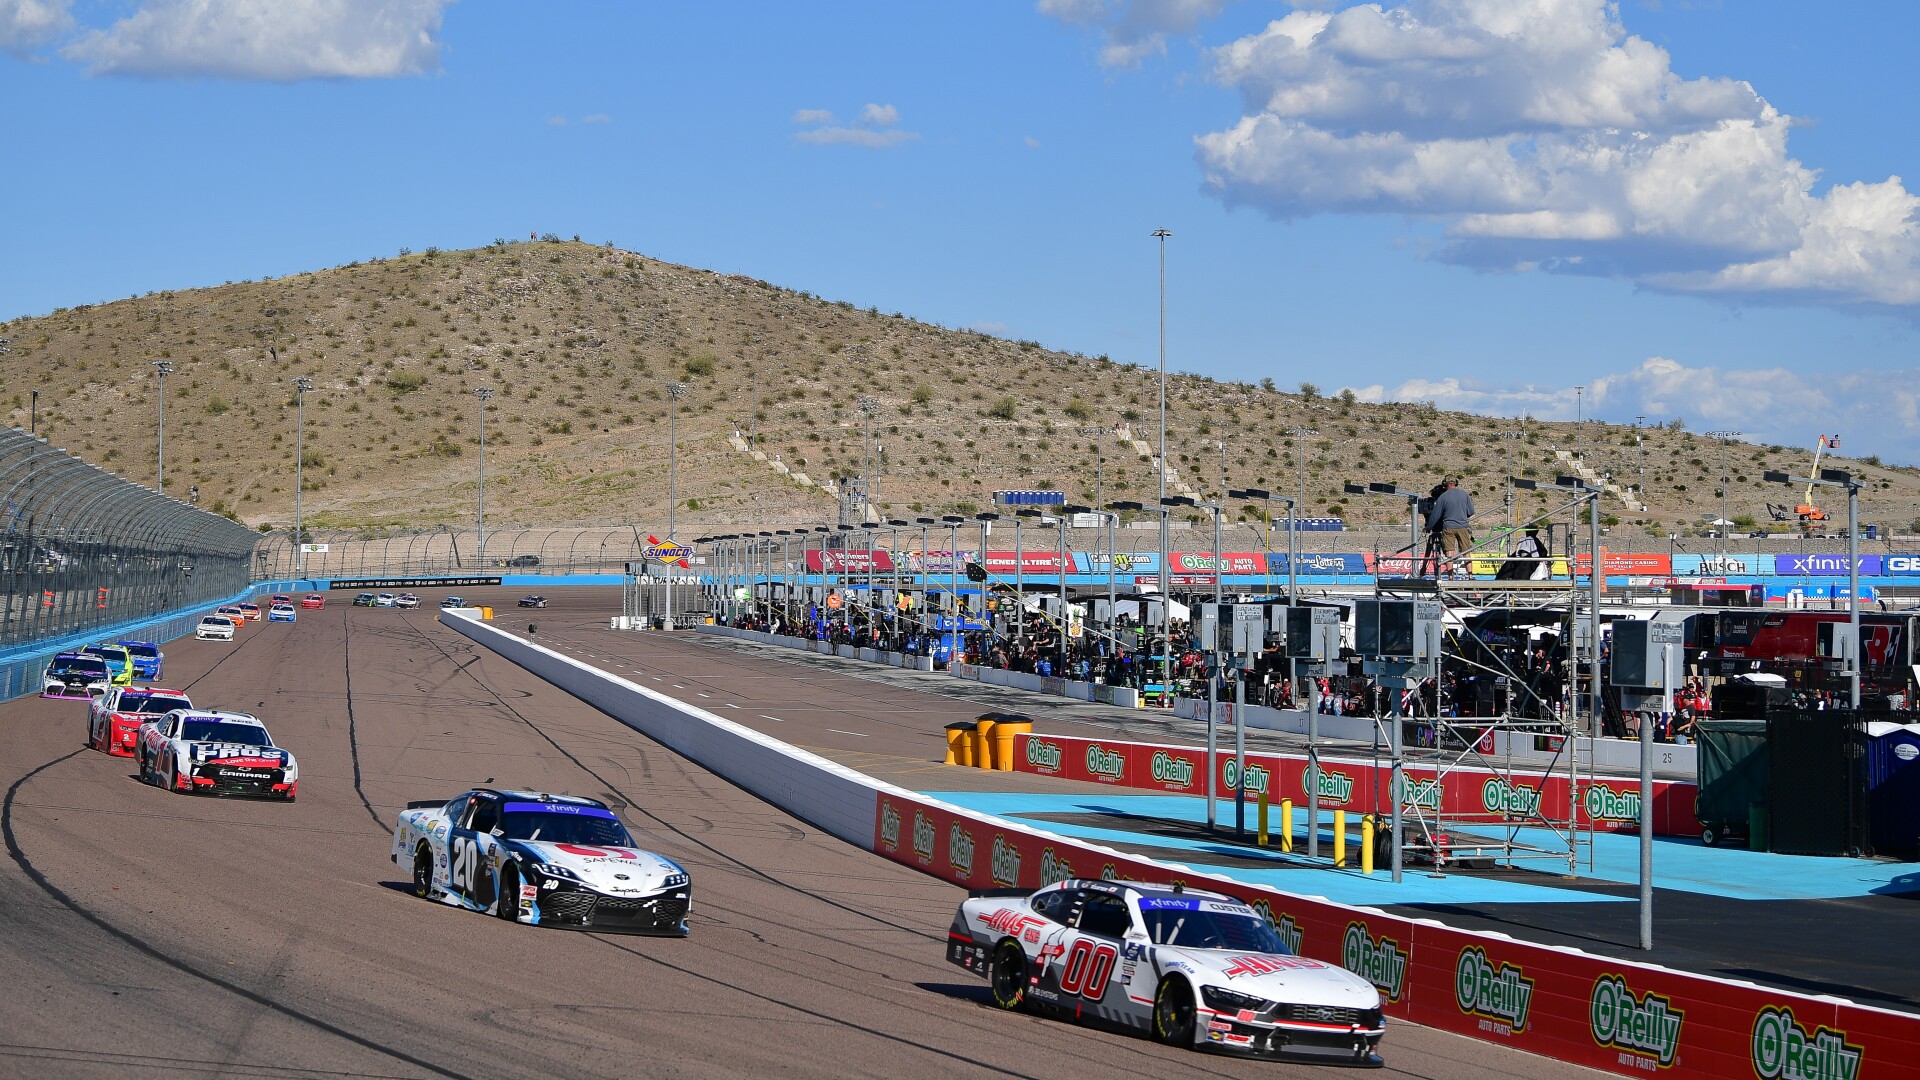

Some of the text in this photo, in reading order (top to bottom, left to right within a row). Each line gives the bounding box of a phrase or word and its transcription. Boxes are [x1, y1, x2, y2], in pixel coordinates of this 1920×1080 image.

[648, 548, 690, 557] SUNOCO
[1310, 555, 1344, 571] Lottery
[1699, 562, 1746, 574] BUSCH
[196, 748, 282, 761] PROS
[1027, 737, 1061, 771] O'Reilly
[1663, 752, 1673, 764] 25
[1087, 745, 1123, 780] O'Reilly
[1153, 751, 1192, 787] O'Reilly
[192, 768, 200, 776] 1
[219, 771, 271, 779] CAMARO
[545, 804, 580, 814] xfinity
[1606, 821, 1633, 829] AUTO PARTS
[452, 837, 478, 892] 20
[583, 856, 643, 868] SAFEWAY
[542, 879, 560, 890] 20
[609, 886, 641, 896] Supra
[1151, 898, 1252, 915] xfinity CUSTER
[1060, 937, 1117, 1002] 00
[1343, 925, 1406, 1001] O'Reilly
[1456, 950, 1532, 1029] O'Reilly
[1591, 979, 1680, 1058] O'Reilly
[1478, 1019, 1511, 1037] AUTO PARTS
[1753, 1011, 1861, 1080] O'Reilly
[1618, 1052, 1657, 1073] AUTO PARTS
